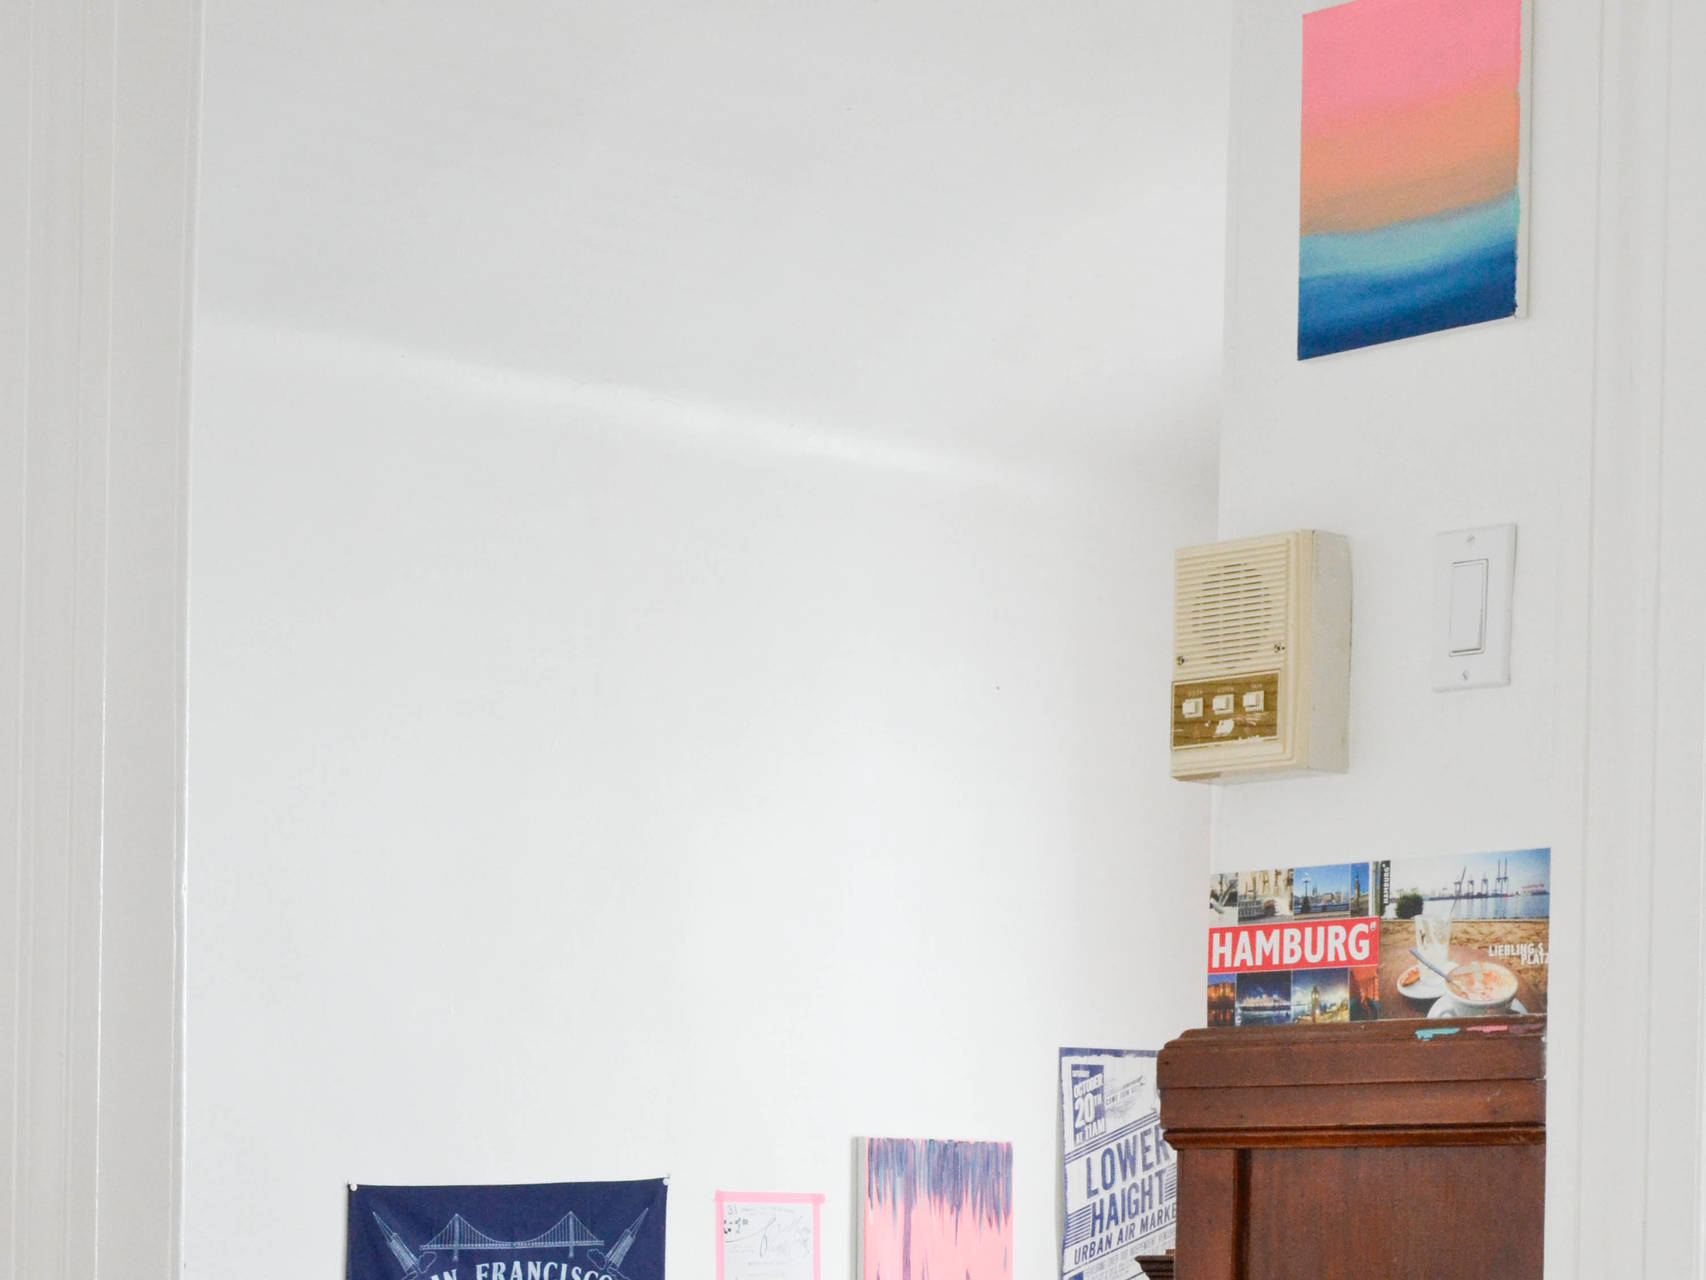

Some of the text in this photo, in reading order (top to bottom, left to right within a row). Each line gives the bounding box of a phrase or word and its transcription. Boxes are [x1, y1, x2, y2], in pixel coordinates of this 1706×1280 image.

[1211, 922, 1371, 969] HAMBURG
[1086, 1124, 1171, 1199] LOWER
[1074, 1233, 1113, 1265] URBAN
[1117, 1222, 1136, 1245] AIR
[1140, 1203, 1177, 1234] MARKE
[1090, 1169, 1166, 1237] HAIGHT
